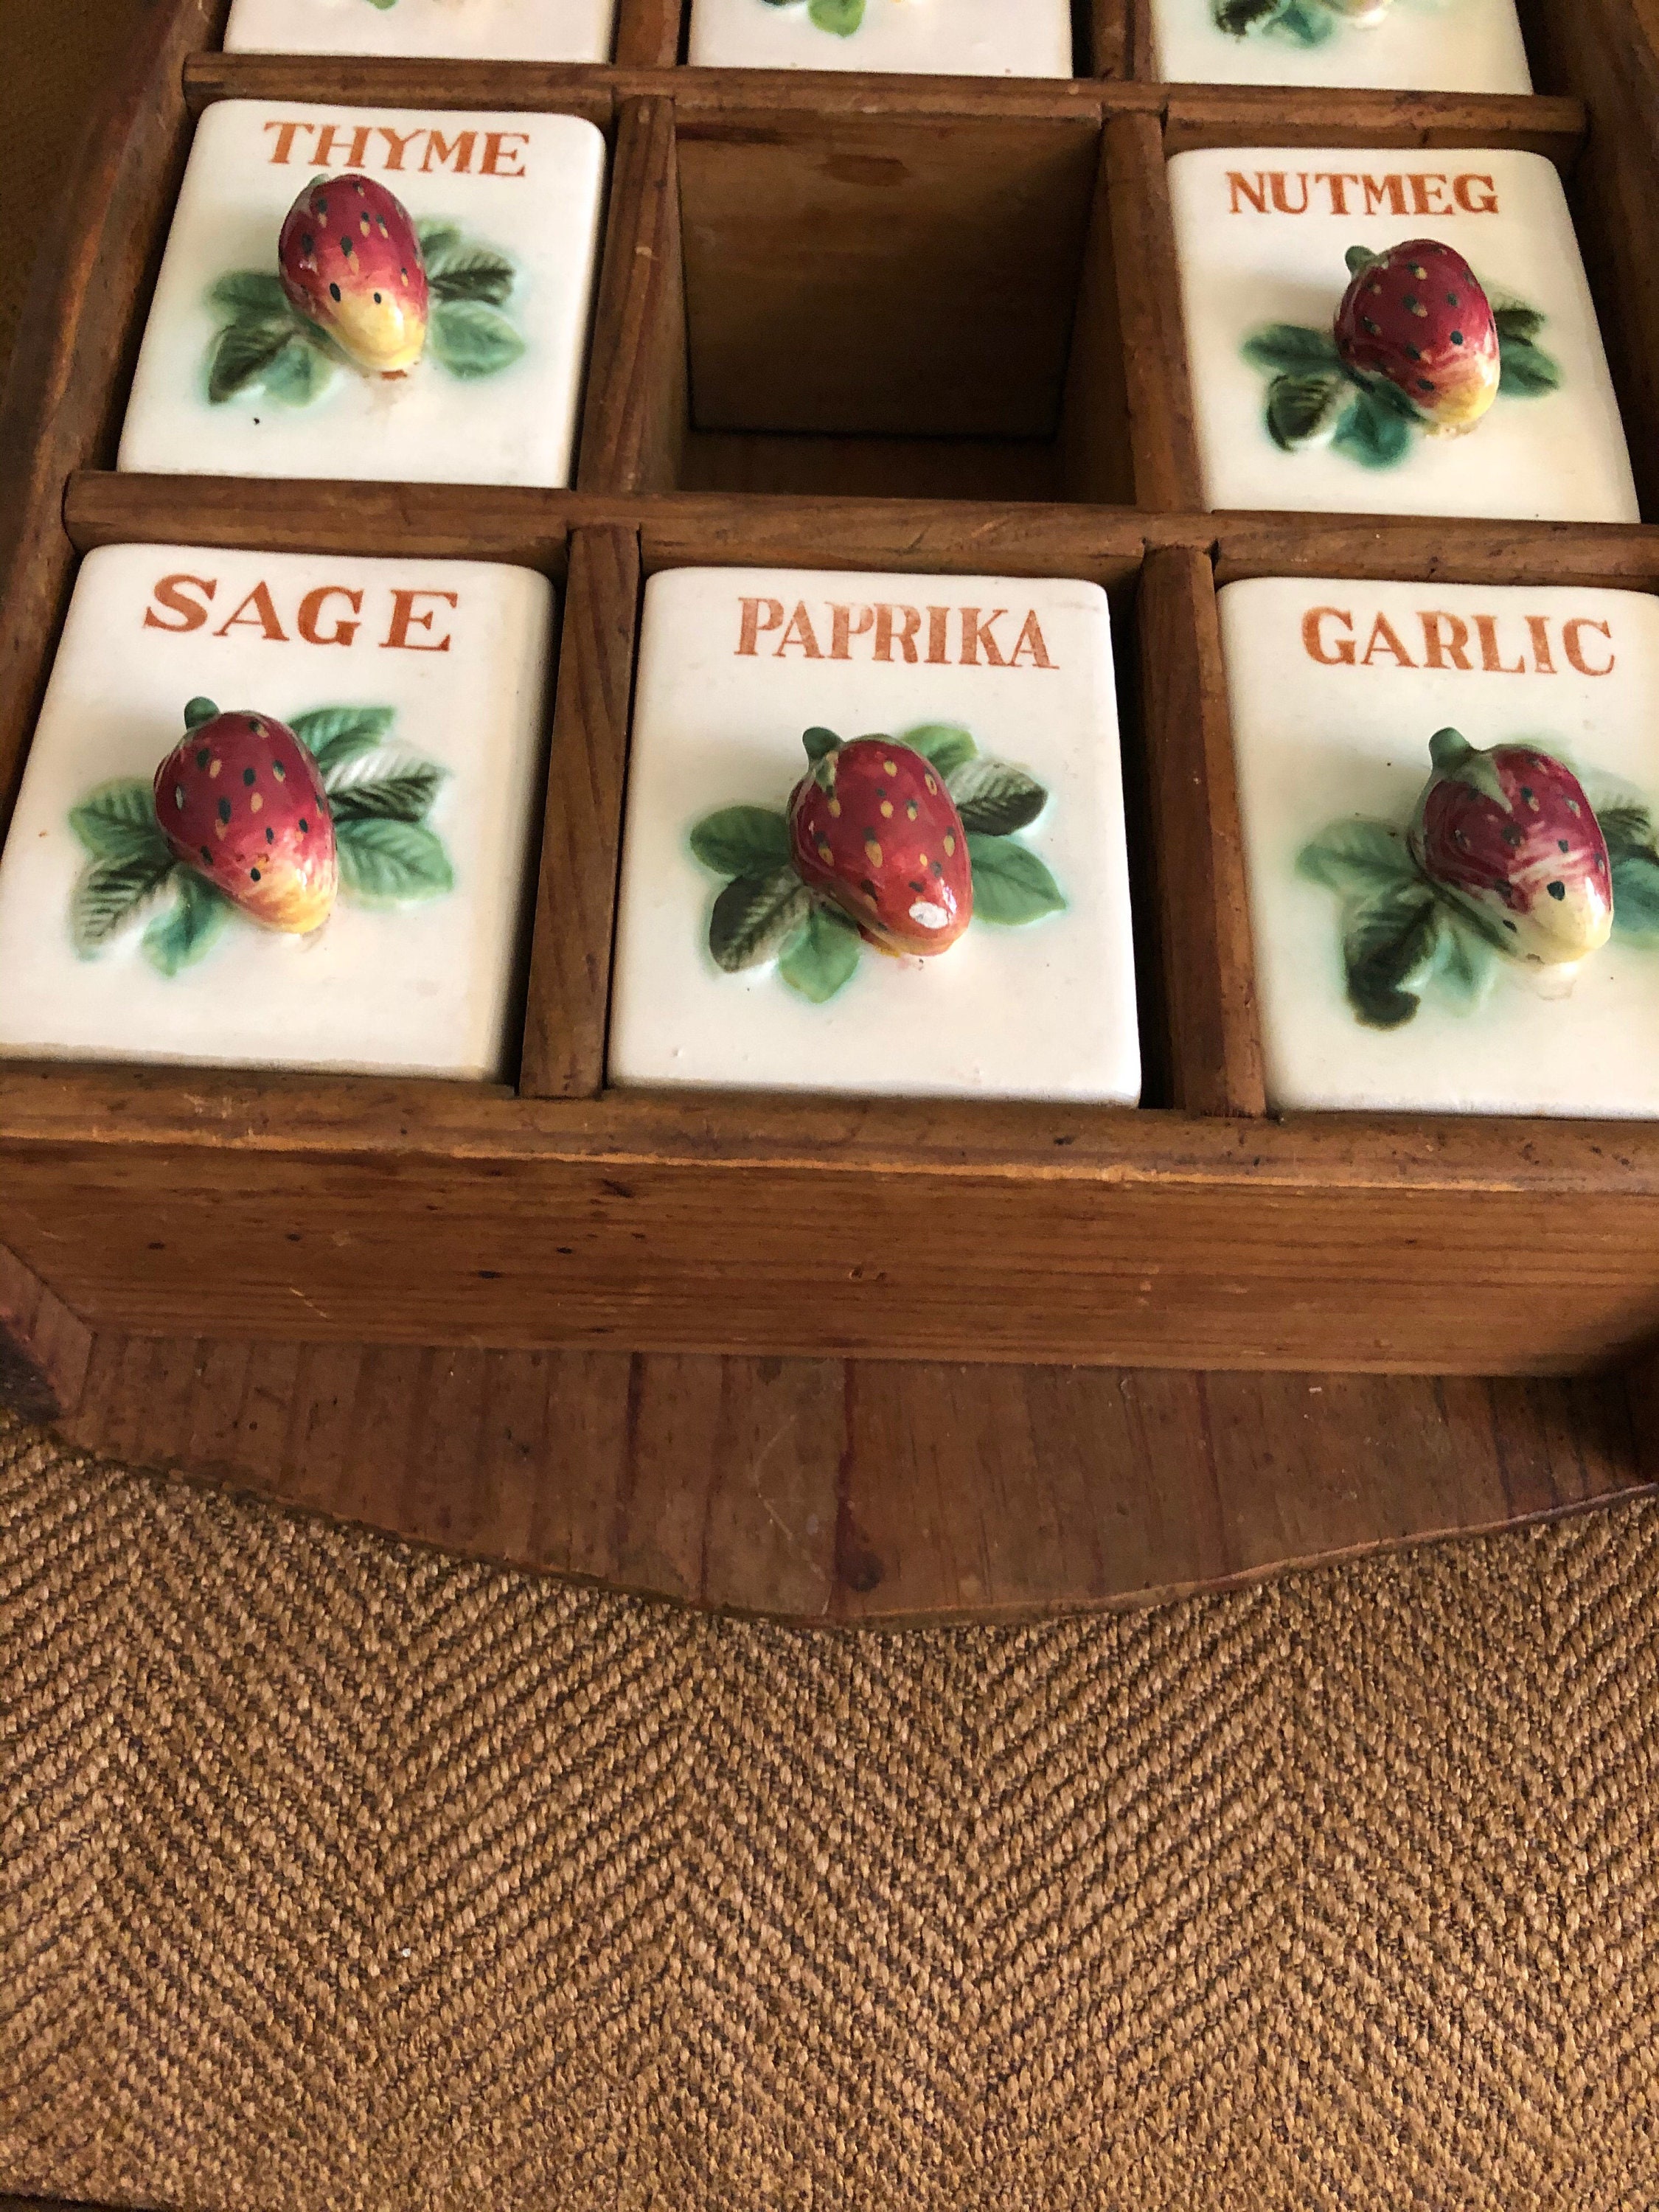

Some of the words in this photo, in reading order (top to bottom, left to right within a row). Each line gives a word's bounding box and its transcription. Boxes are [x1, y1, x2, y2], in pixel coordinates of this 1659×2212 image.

[263, 120, 530, 178] THYME
[1226, 170, 1501, 216] NUTMEG
[144, 574, 459, 653] SAGE
[736, 598, 1059, 669] PAPRIKA
[1302, 606, 1615, 677] GARLIC
